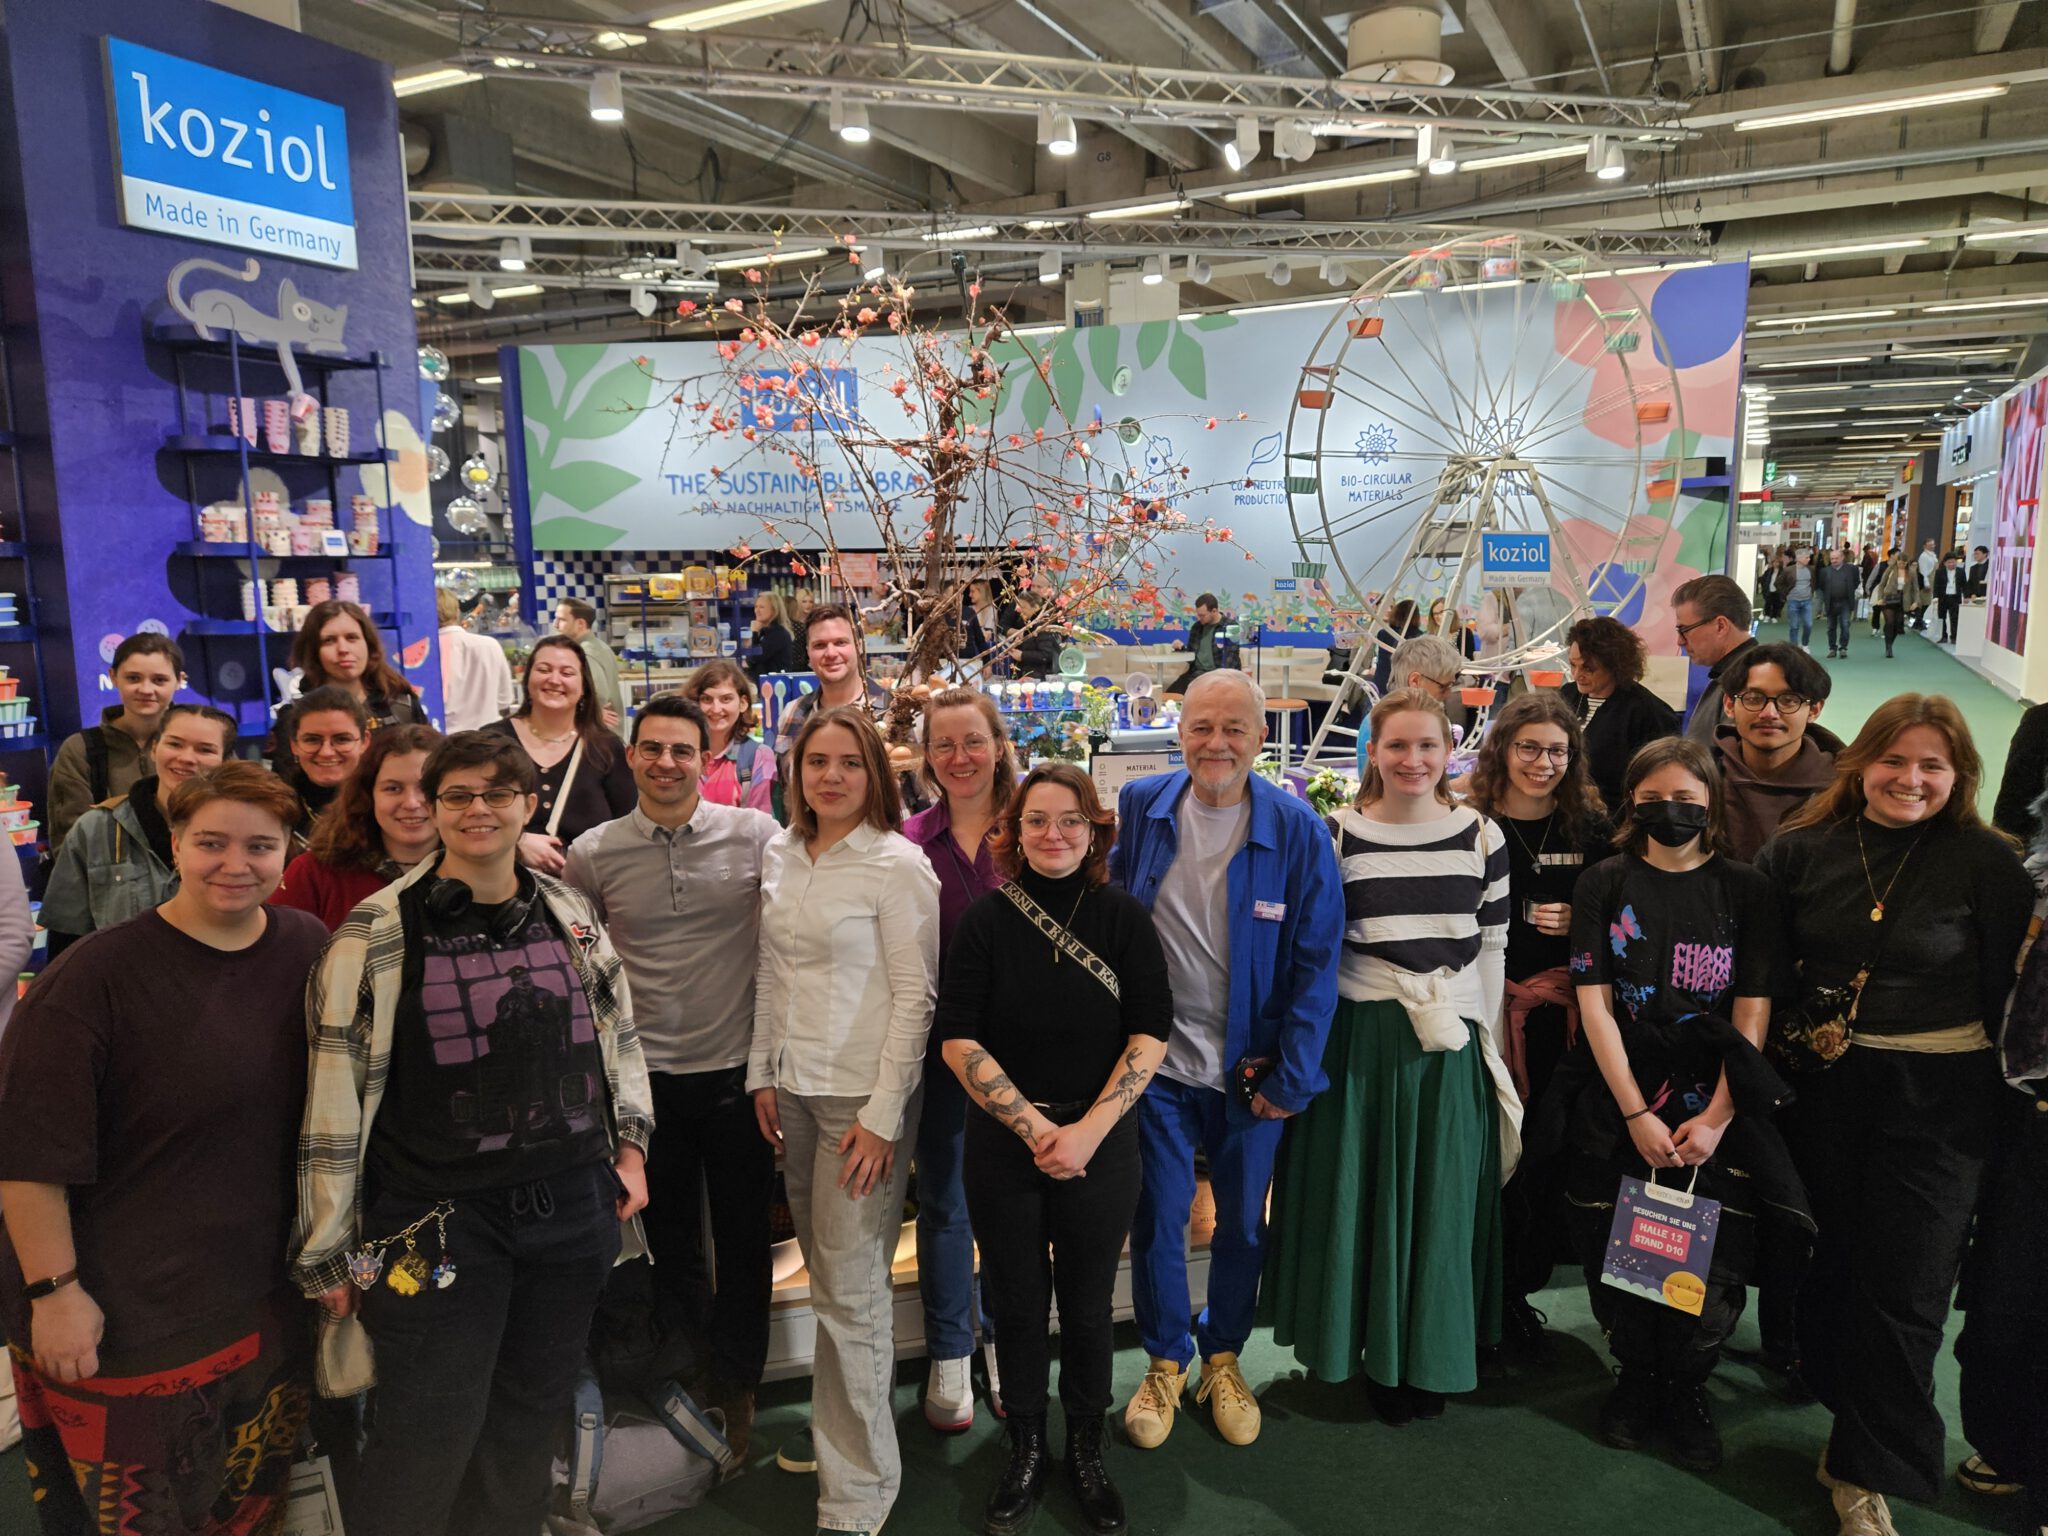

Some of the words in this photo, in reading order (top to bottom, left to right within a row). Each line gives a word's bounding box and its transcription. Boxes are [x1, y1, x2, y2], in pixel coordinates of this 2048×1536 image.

[131, 71, 336, 191] koziol
[1097, 151, 1112, 162] G8
[145, 192, 208, 228] Made
[217, 207, 240, 235] in
[249, 215, 341, 261] Germany
[664, 473, 706, 495] THE
[718, 471, 861, 495] SUSTAINABLE
[1341, 472, 1412, 487] BIO-CIRCULAR
[1348, 489, 1403, 502] MATERIALS
[1488, 541, 1545, 563] koziol
[1126, 764, 1156, 772] MATERIAL
[1633, 1206, 1668, 1222] BESUCHEN
[1669, 1216, 1681, 1227] SIE
[1682, 1220, 1697, 1231] UNS
[1639, 1222, 1669, 1239] HALLE
[1634, 1233, 1664, 1250] STAND
[1666, 1243, 1684, 1257] D10
